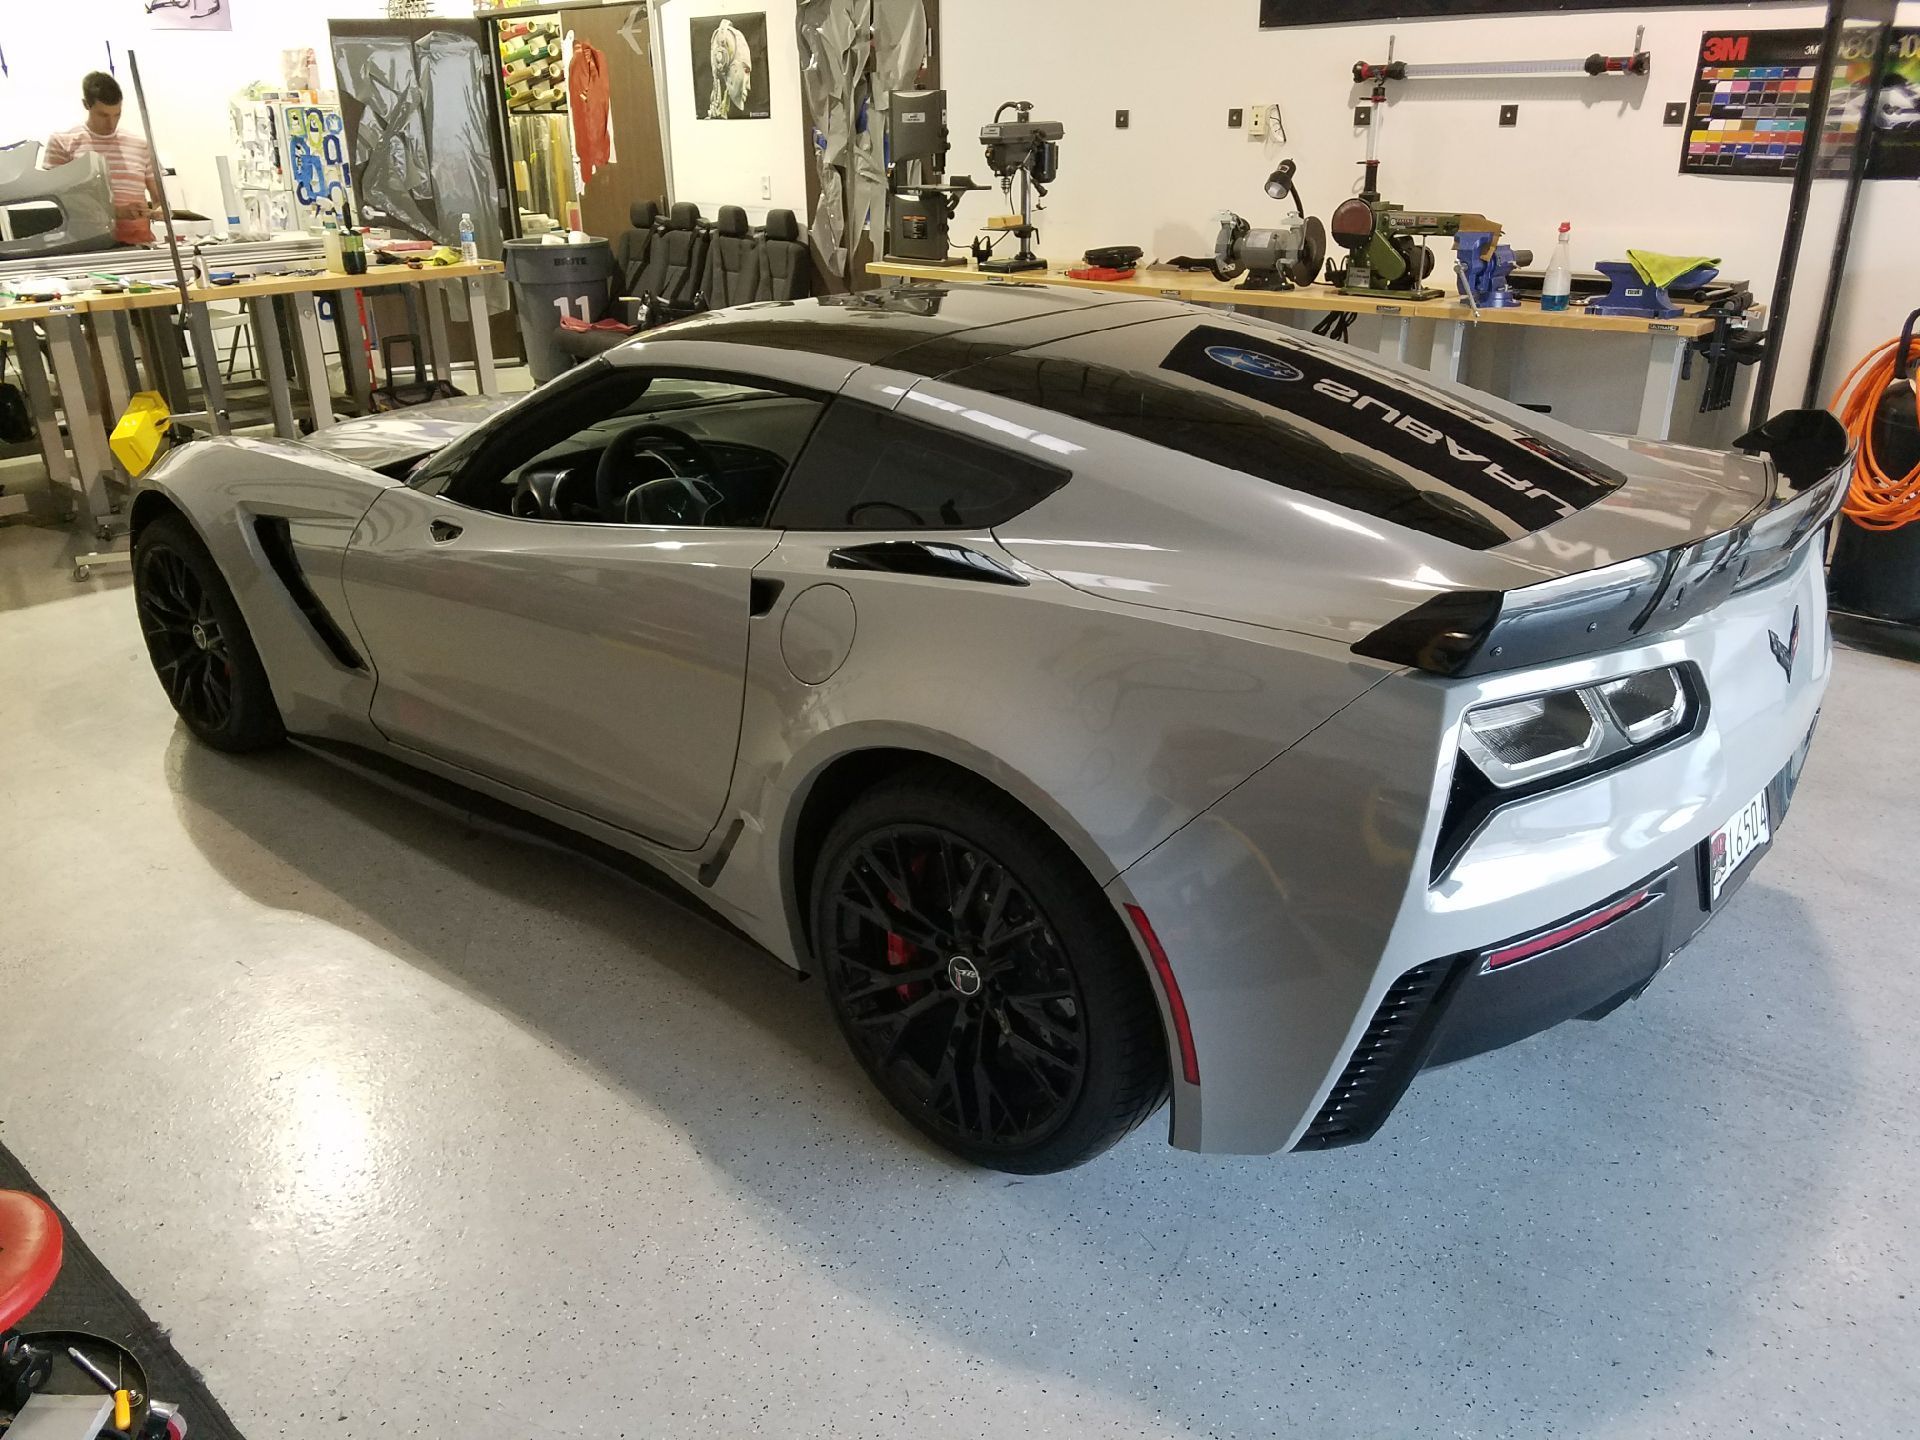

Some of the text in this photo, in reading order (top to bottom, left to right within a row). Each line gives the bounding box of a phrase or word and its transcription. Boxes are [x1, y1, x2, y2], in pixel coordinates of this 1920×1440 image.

[1703, 37, 1749, 61] 3M
[554, 296, 590, 325] 11
[1729, 792, 1767, 867] 16504
